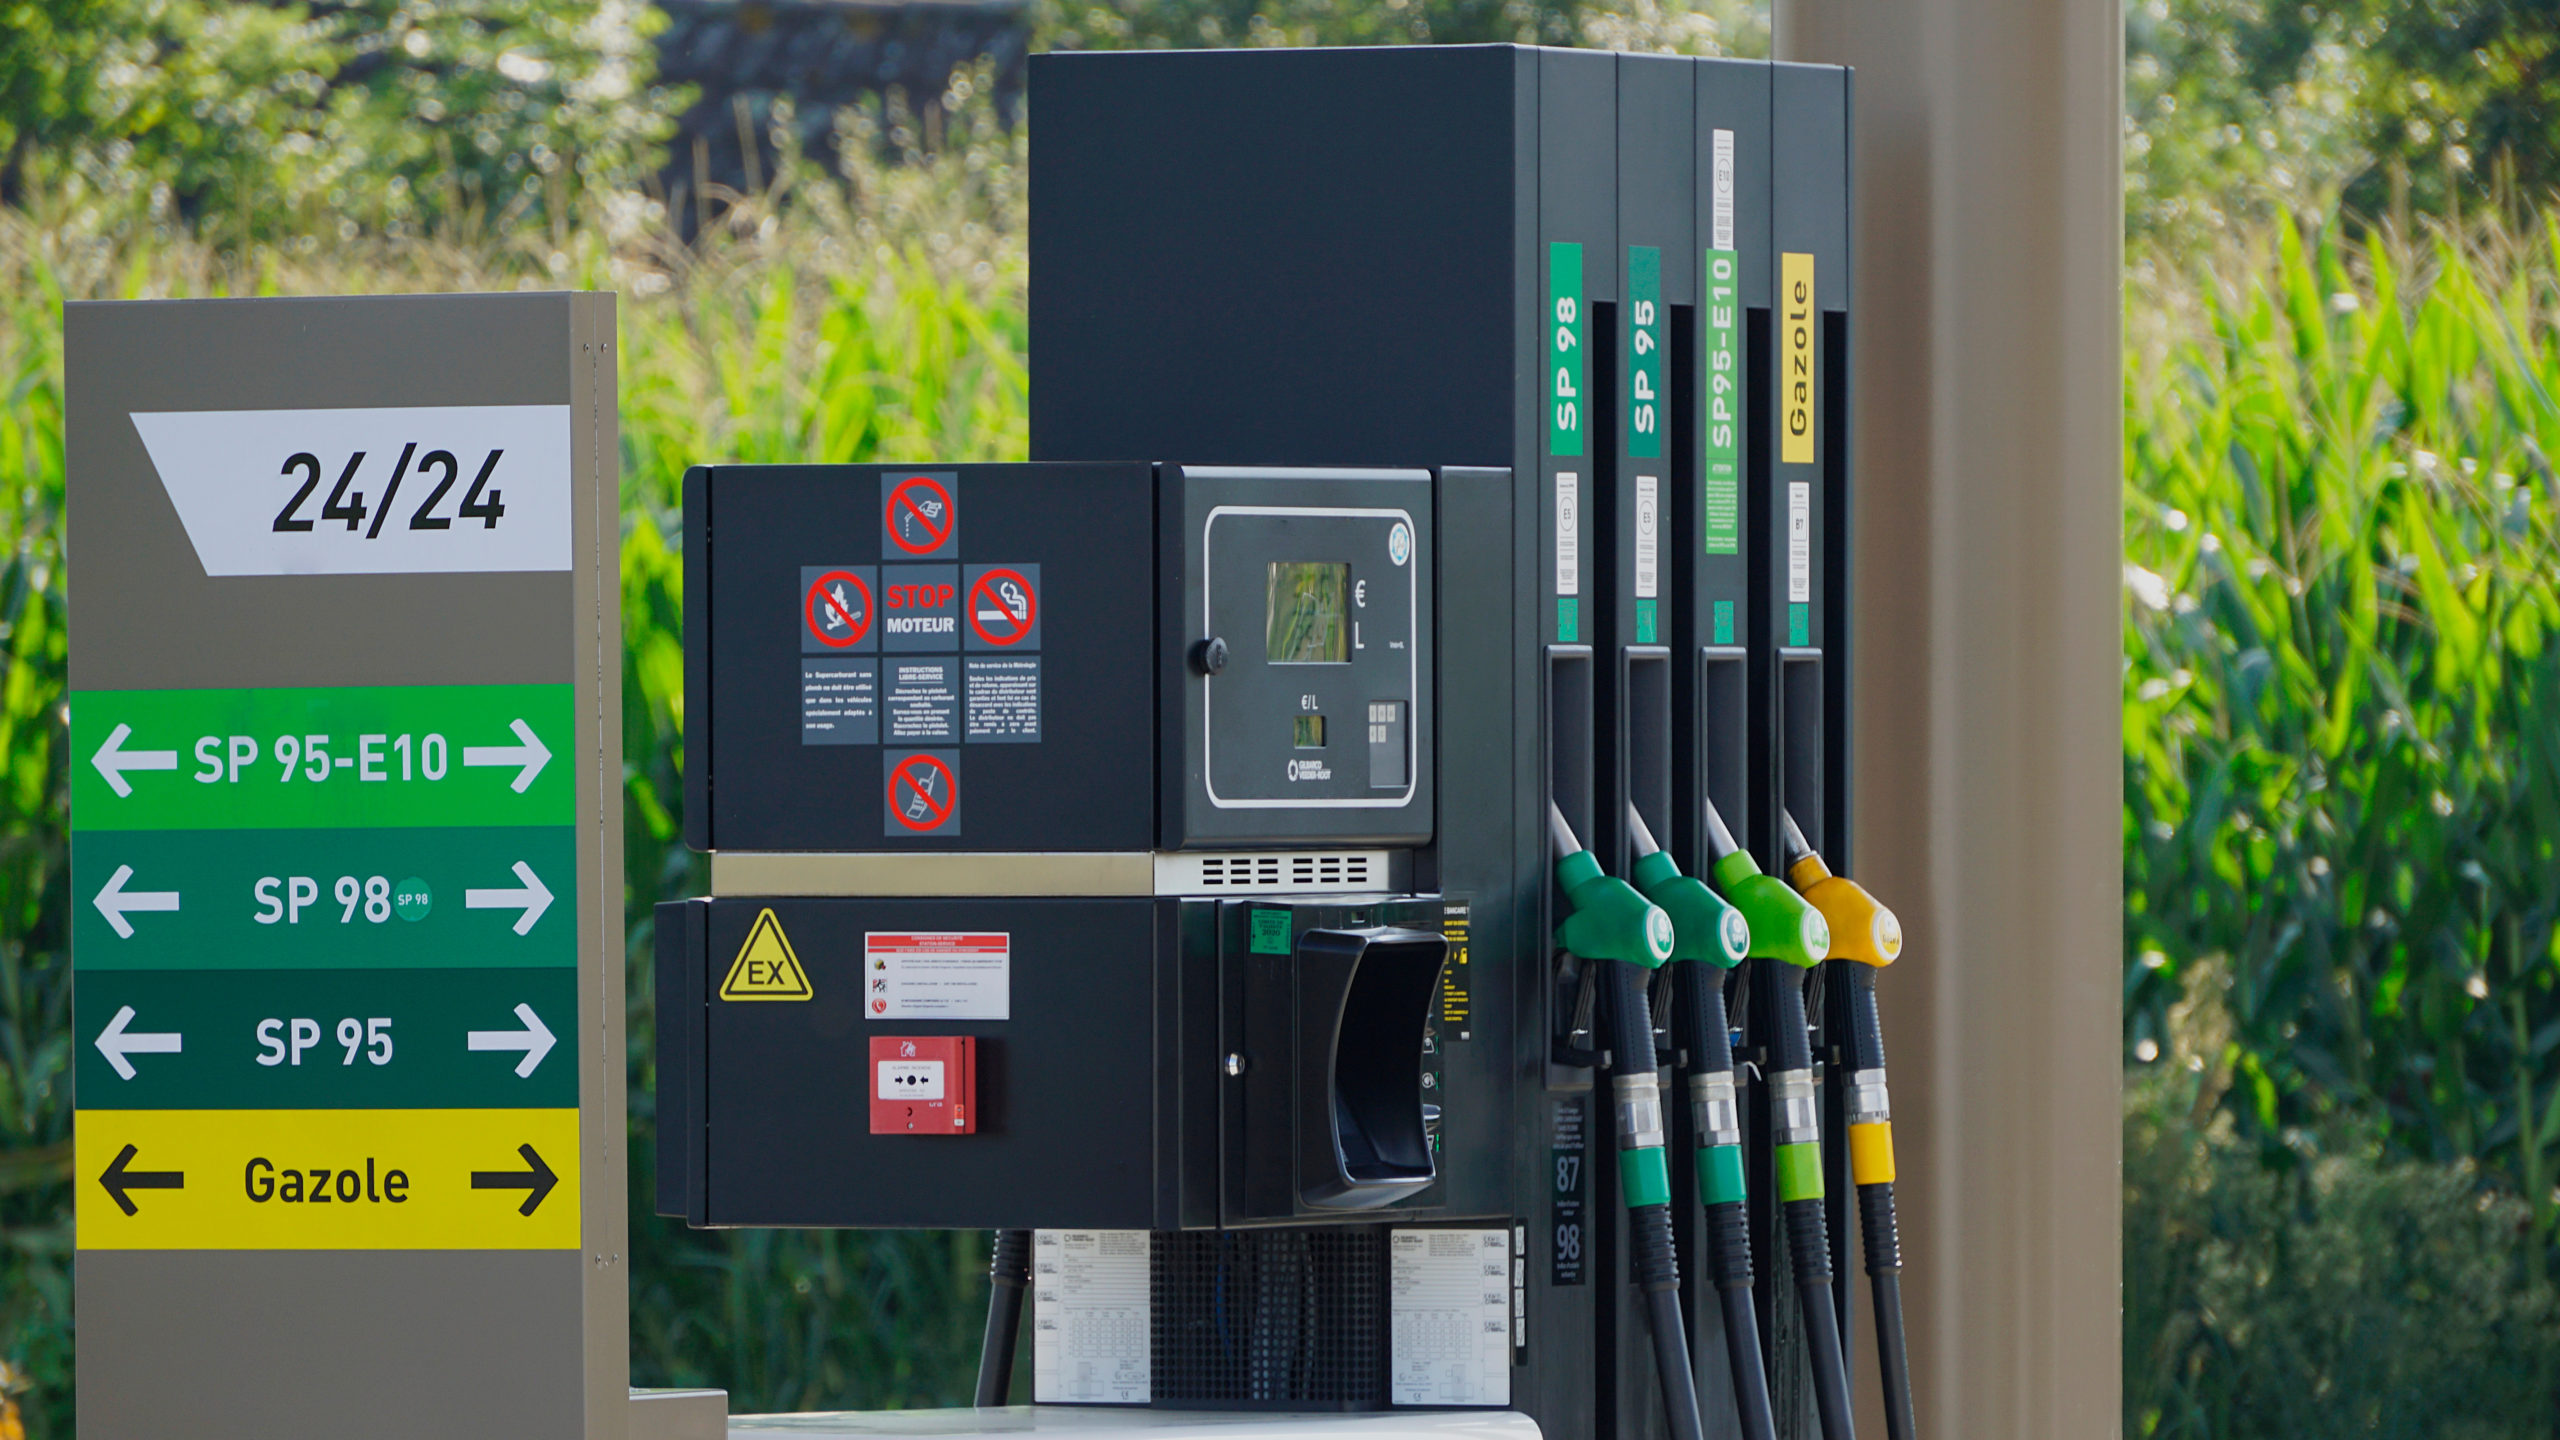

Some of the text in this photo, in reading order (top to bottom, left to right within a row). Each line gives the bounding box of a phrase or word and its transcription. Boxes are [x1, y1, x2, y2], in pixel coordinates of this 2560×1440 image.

[1556, 296, 1577, 431] SP 98
[1634, 300, 1655, 434] SP 95
[1713, 258, 1732, 448] SP95-E10
[1790, 280, 1807, 436] Gazole
[272, 442, 505, 539] 24/24
[887, 584, 954, 608] STOP
[887, 617, 954, 633] MOTEUR
[1355, 622, 1365, 649] L
[194, 733, 447, 784] SP 95-E10
[253, 875, 392, 925] SP 98
[397, 893, 428, 906] SP 98
[748, 960, 785, 985] EX
[255, 1017, 393, 1067] SP 95
[245, 1156, 410, 1204] Gazole
[1557, 1156, 1580, 1192] 87
[1557, 1224, 1580, 1260] 98
